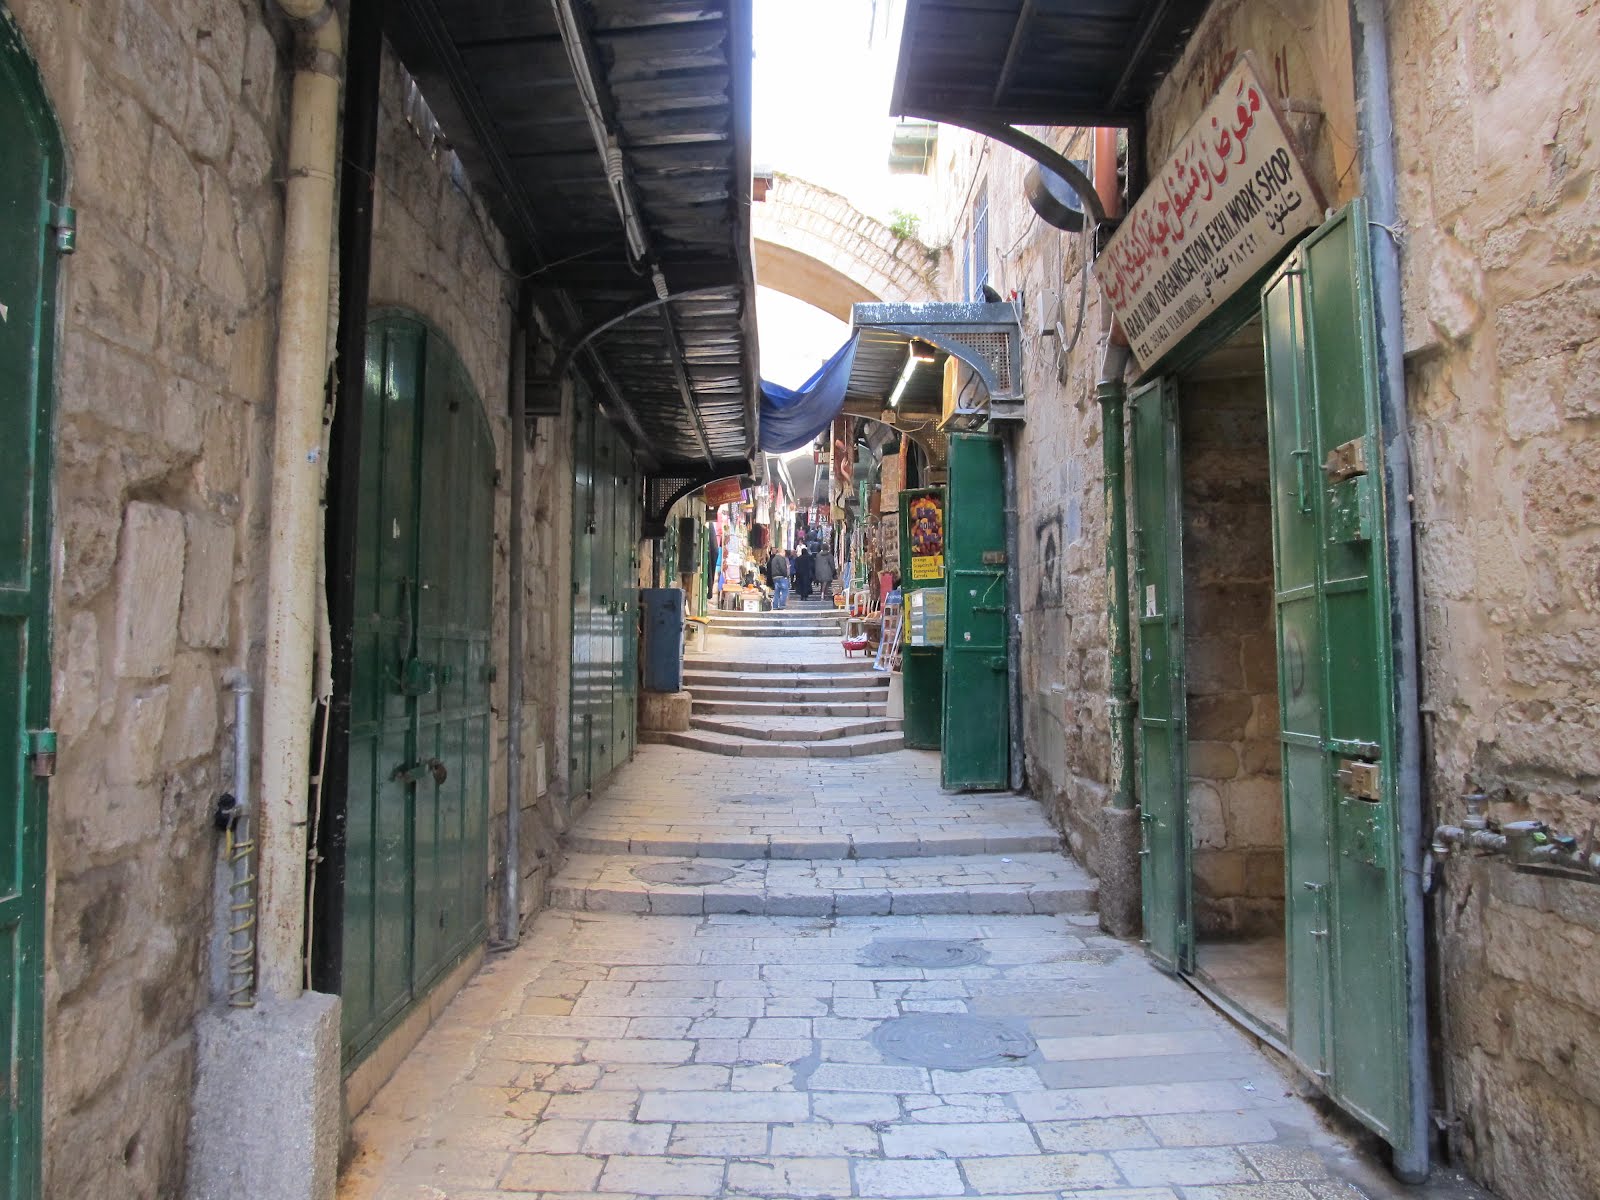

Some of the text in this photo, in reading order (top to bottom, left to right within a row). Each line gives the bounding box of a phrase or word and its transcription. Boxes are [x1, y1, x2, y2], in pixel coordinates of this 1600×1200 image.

[1123, 309, 1146, 342] ARAB
[1138, 291, 1160, 326] BLIND
[1154, 232, 1214, 307] ORGANISATION
[1166, 313, 1182, 331] VIA
